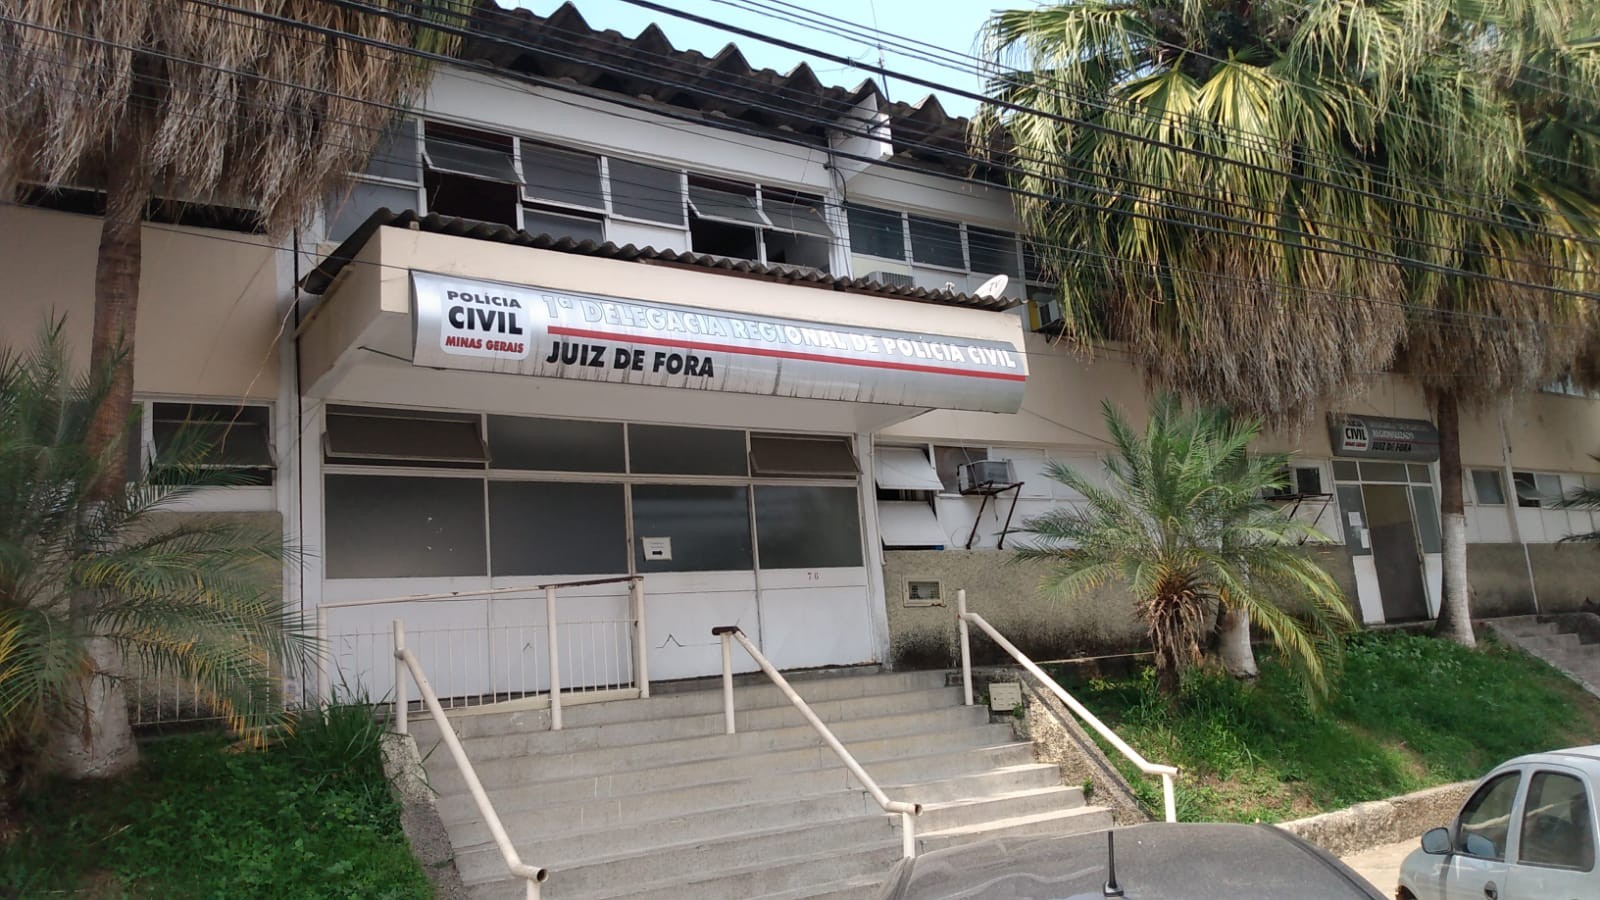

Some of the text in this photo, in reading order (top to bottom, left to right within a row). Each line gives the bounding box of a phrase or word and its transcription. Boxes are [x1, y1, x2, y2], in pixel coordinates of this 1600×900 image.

[447, 290, 522, 309] POLÍCIA
[448, 305, 523, 335] CIVIL
[445, 335, 525, 354] MINAS GERAIS
[581, 300, 728, 338] DELEGACIA
[734, 318, 849, 350] REGIONAL
[850, 333, 879, 353] DE
[880, 336, 965, 364] POLÍCIA
[968, 345, 1017, 368] CIVIL
[546, 341, 714, 378] JUIZ DE FORA
[1345, 427, 1367, 440] CIVIL
